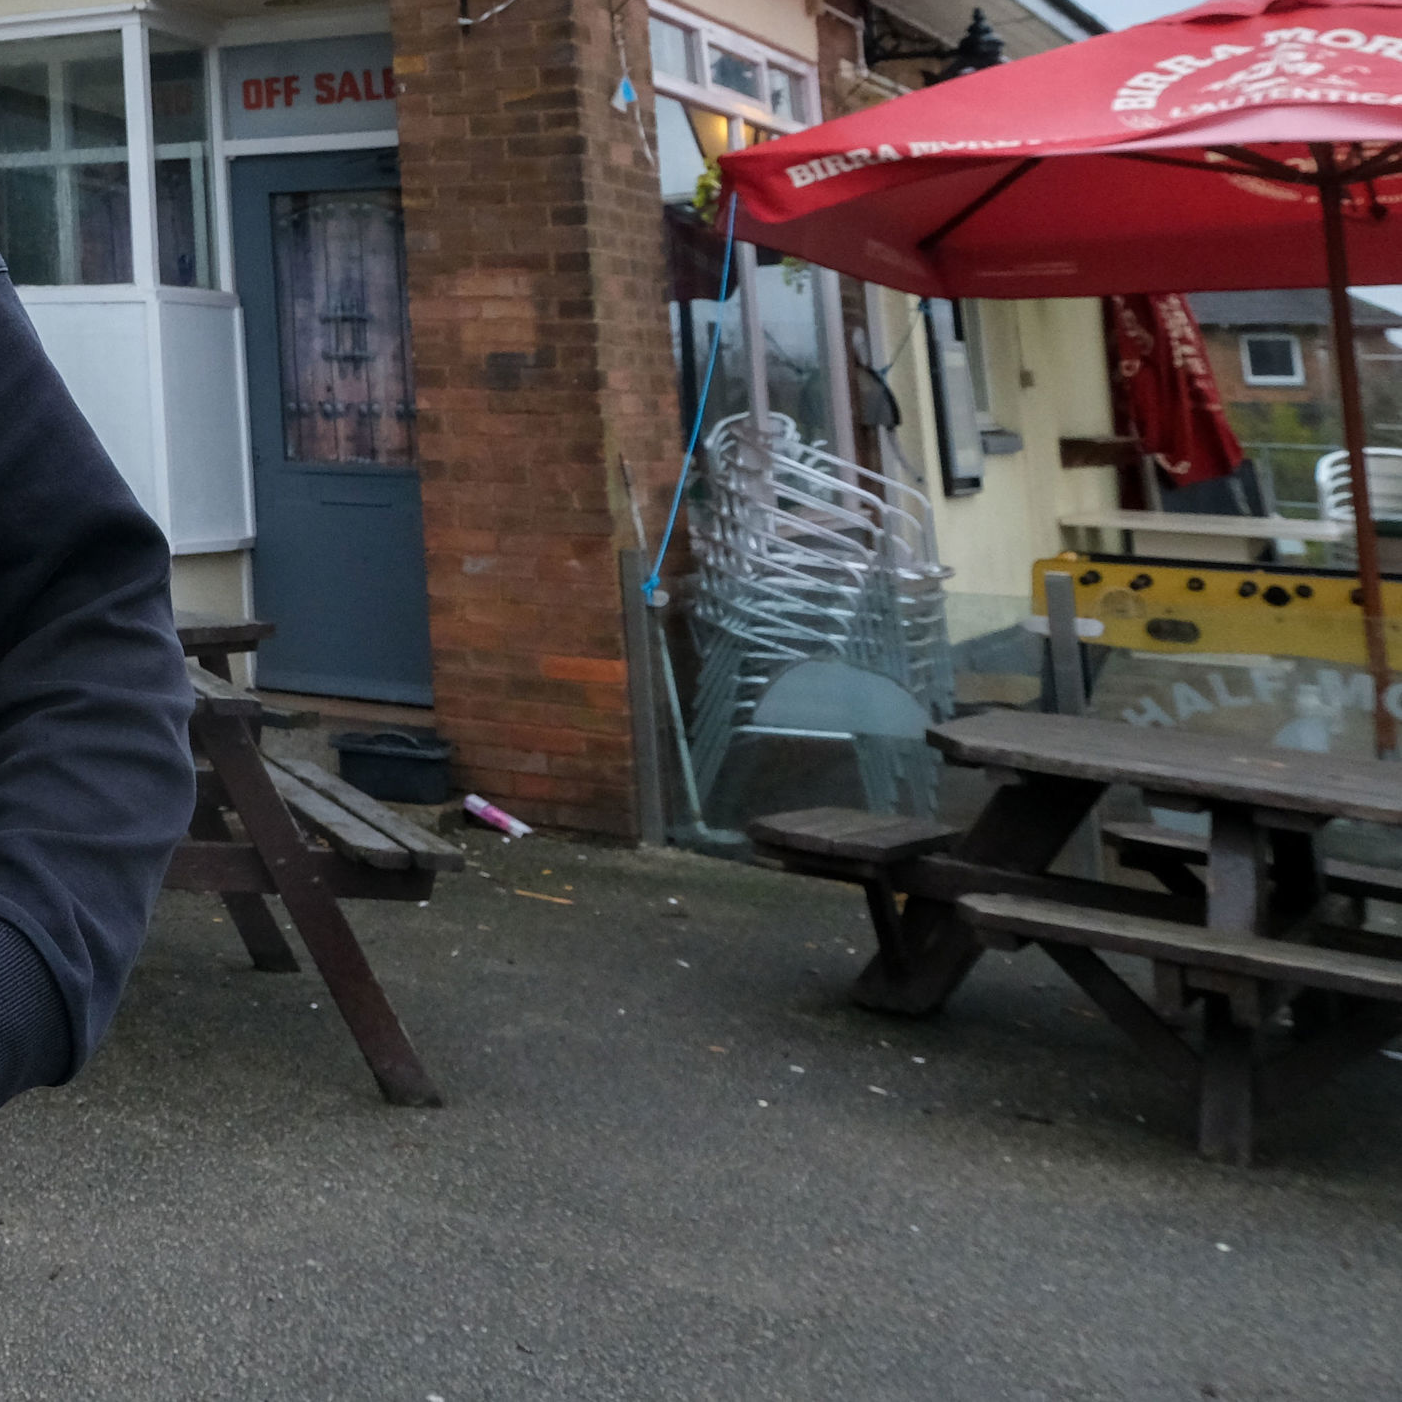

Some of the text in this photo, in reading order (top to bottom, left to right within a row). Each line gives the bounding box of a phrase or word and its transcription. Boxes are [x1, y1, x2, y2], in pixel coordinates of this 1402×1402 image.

[242, 75, 301, 111] OFF
[1111, 44, 1256, 111] BIRRA
[785, 143, 903, 189] BIRRA
